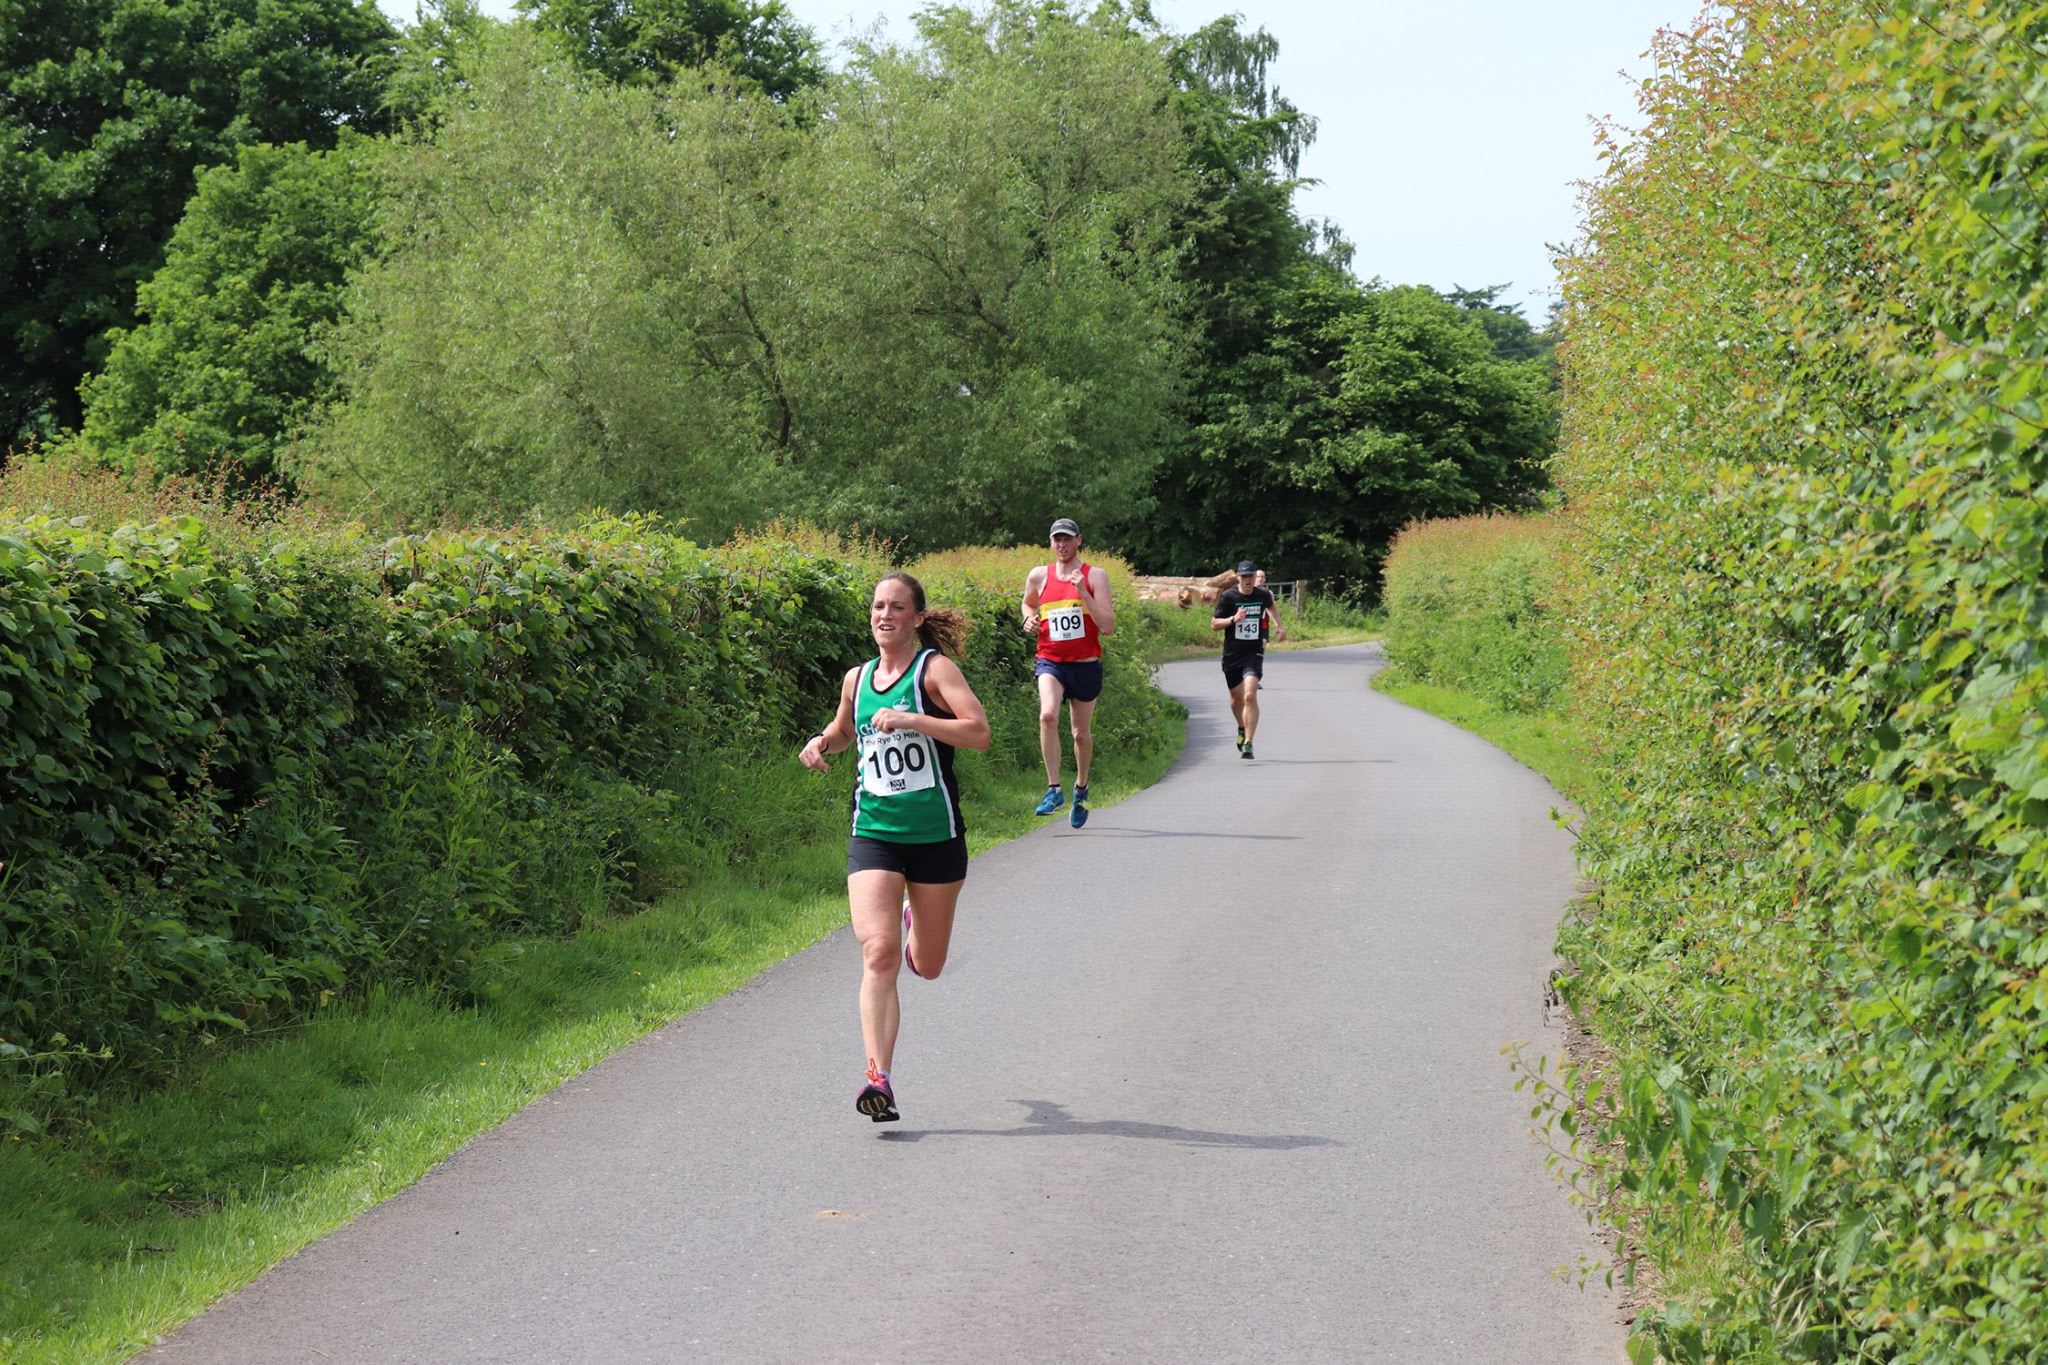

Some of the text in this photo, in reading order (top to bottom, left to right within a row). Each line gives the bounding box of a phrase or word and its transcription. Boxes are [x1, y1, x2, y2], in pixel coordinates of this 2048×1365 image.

[1052, 615, 1081, 631] 109
[1238, 624, 1258, 634] 143
[869, 743, 925, 779] 100
